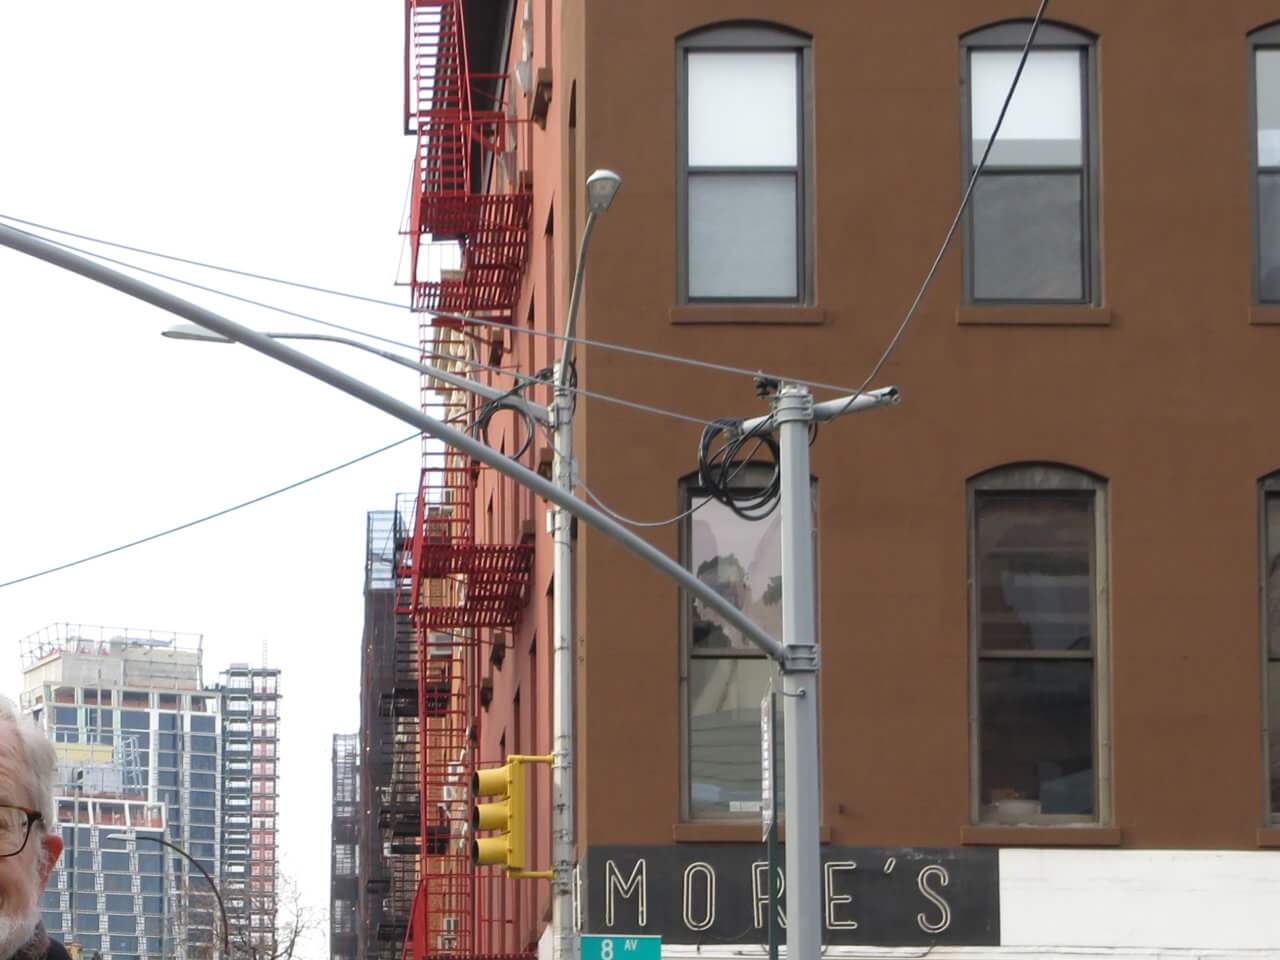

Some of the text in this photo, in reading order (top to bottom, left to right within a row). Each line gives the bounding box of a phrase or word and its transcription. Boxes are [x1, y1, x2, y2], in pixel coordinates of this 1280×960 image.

[604, 857, 951, 934] MORE'S
[600, 938, 638, 960] 8 AV
